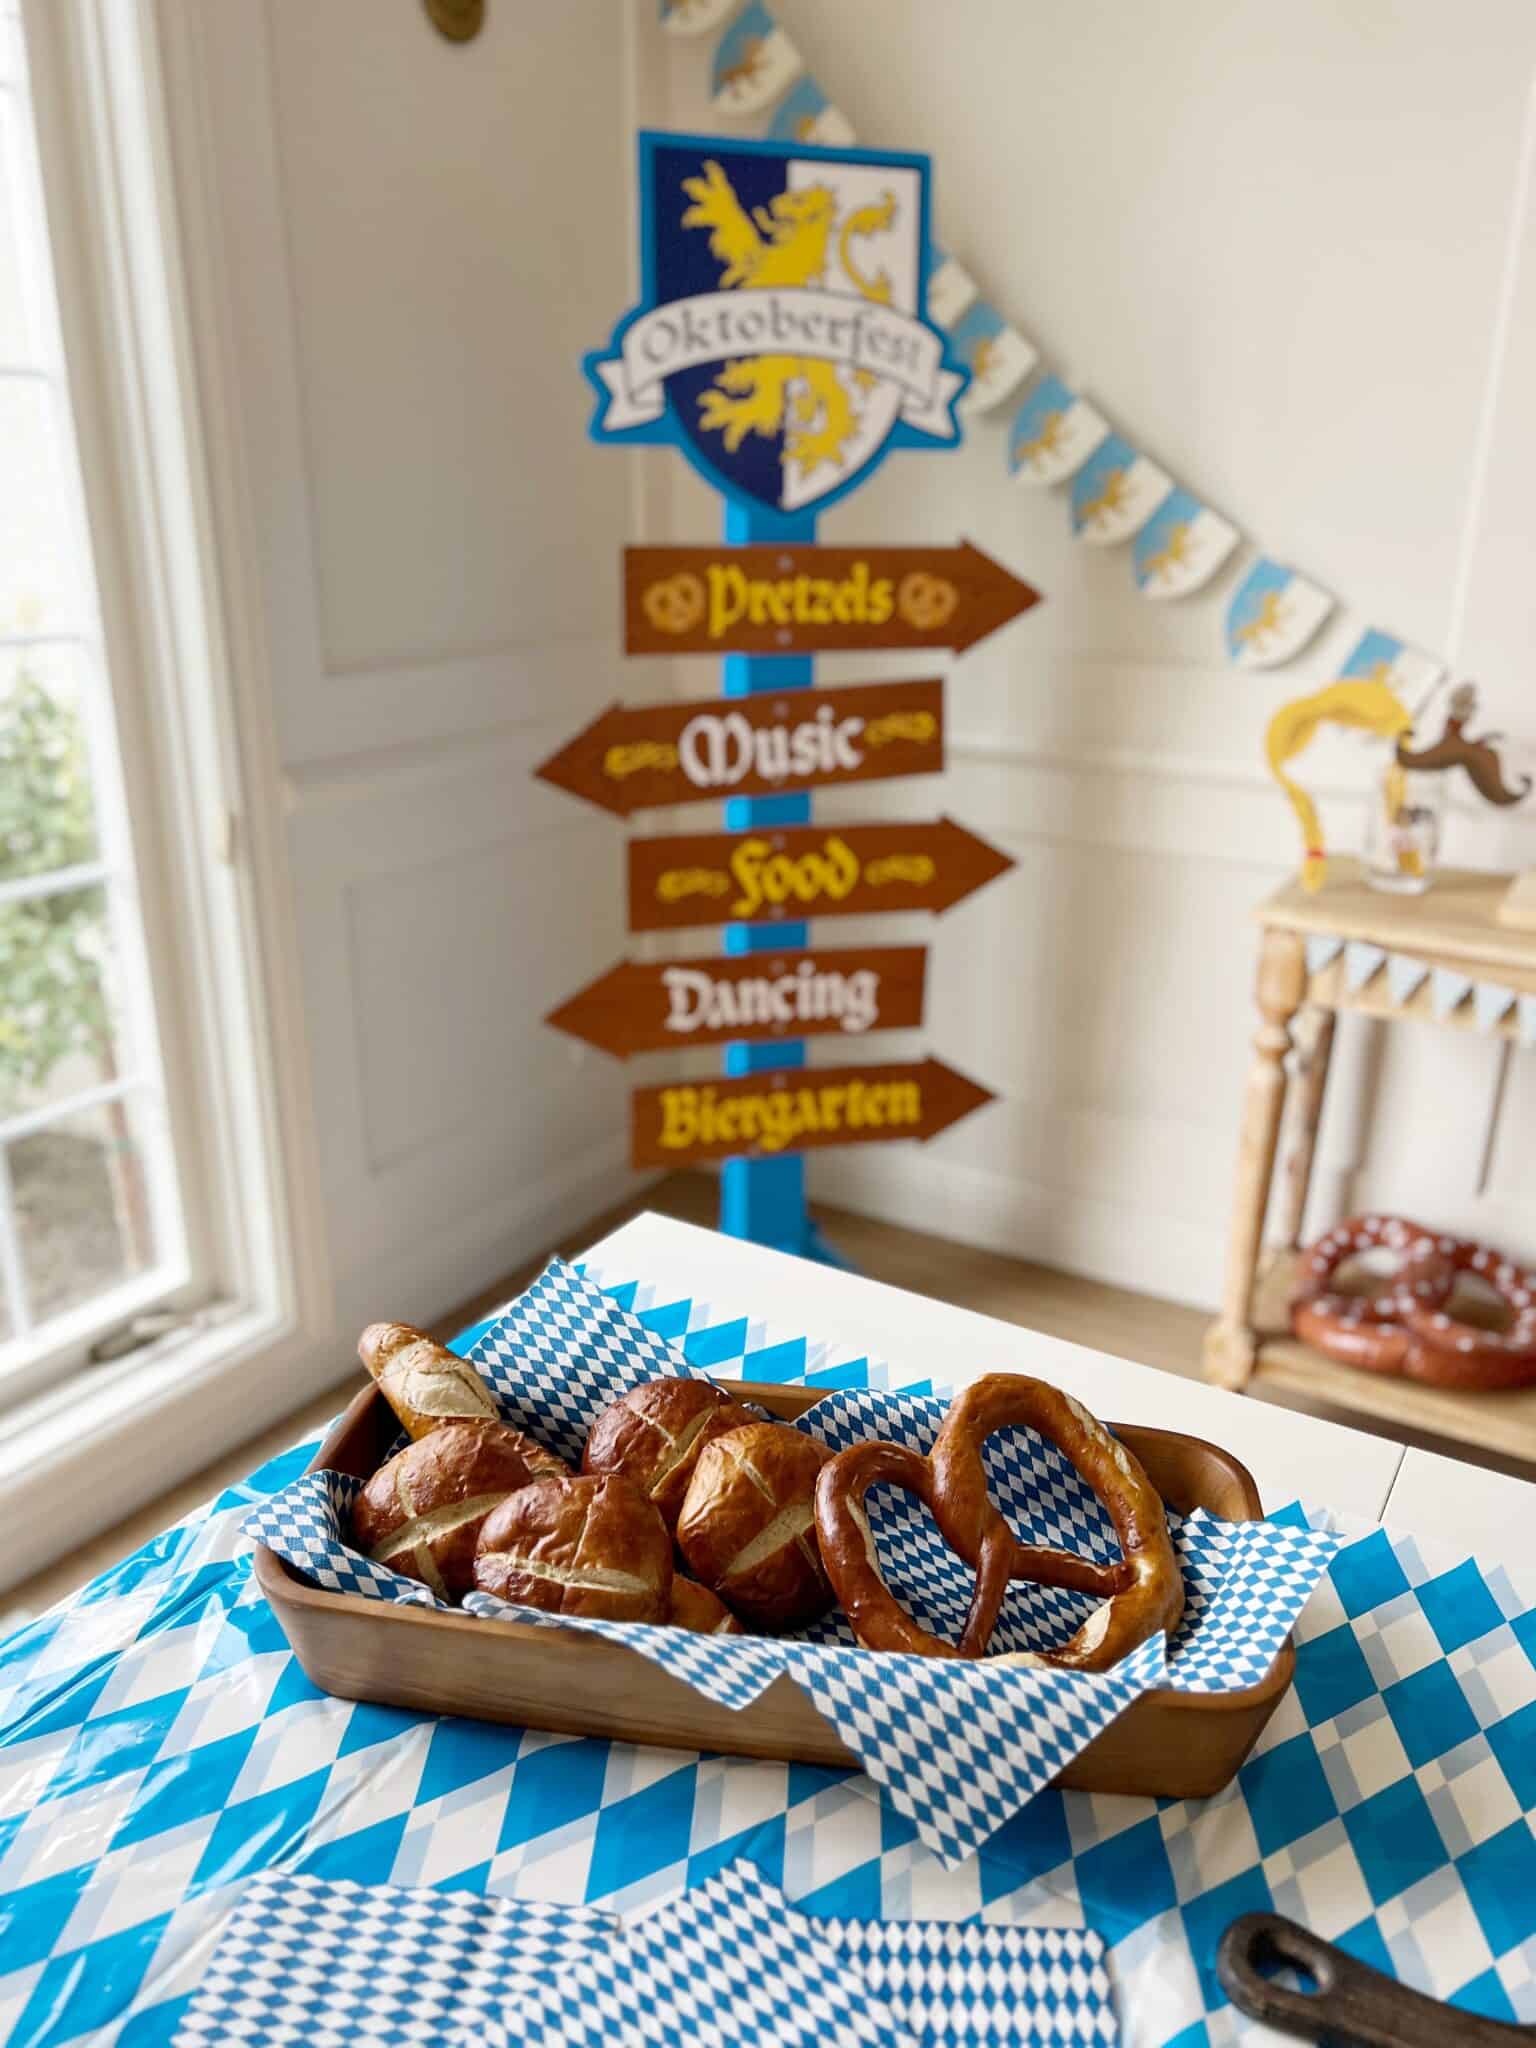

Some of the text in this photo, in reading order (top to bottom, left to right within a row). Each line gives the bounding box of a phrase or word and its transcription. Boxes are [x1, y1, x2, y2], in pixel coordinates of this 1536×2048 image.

[641, 296, 923, 369] Oktoberfest
[706, 561, 895, 639] Pretzels
[678, 705, 866, 788] Music
[730, 837, 860, 917] Food
[661, 960, 880, 1033] Dancing
[658, 1079, 922, 1152] Biergarten
